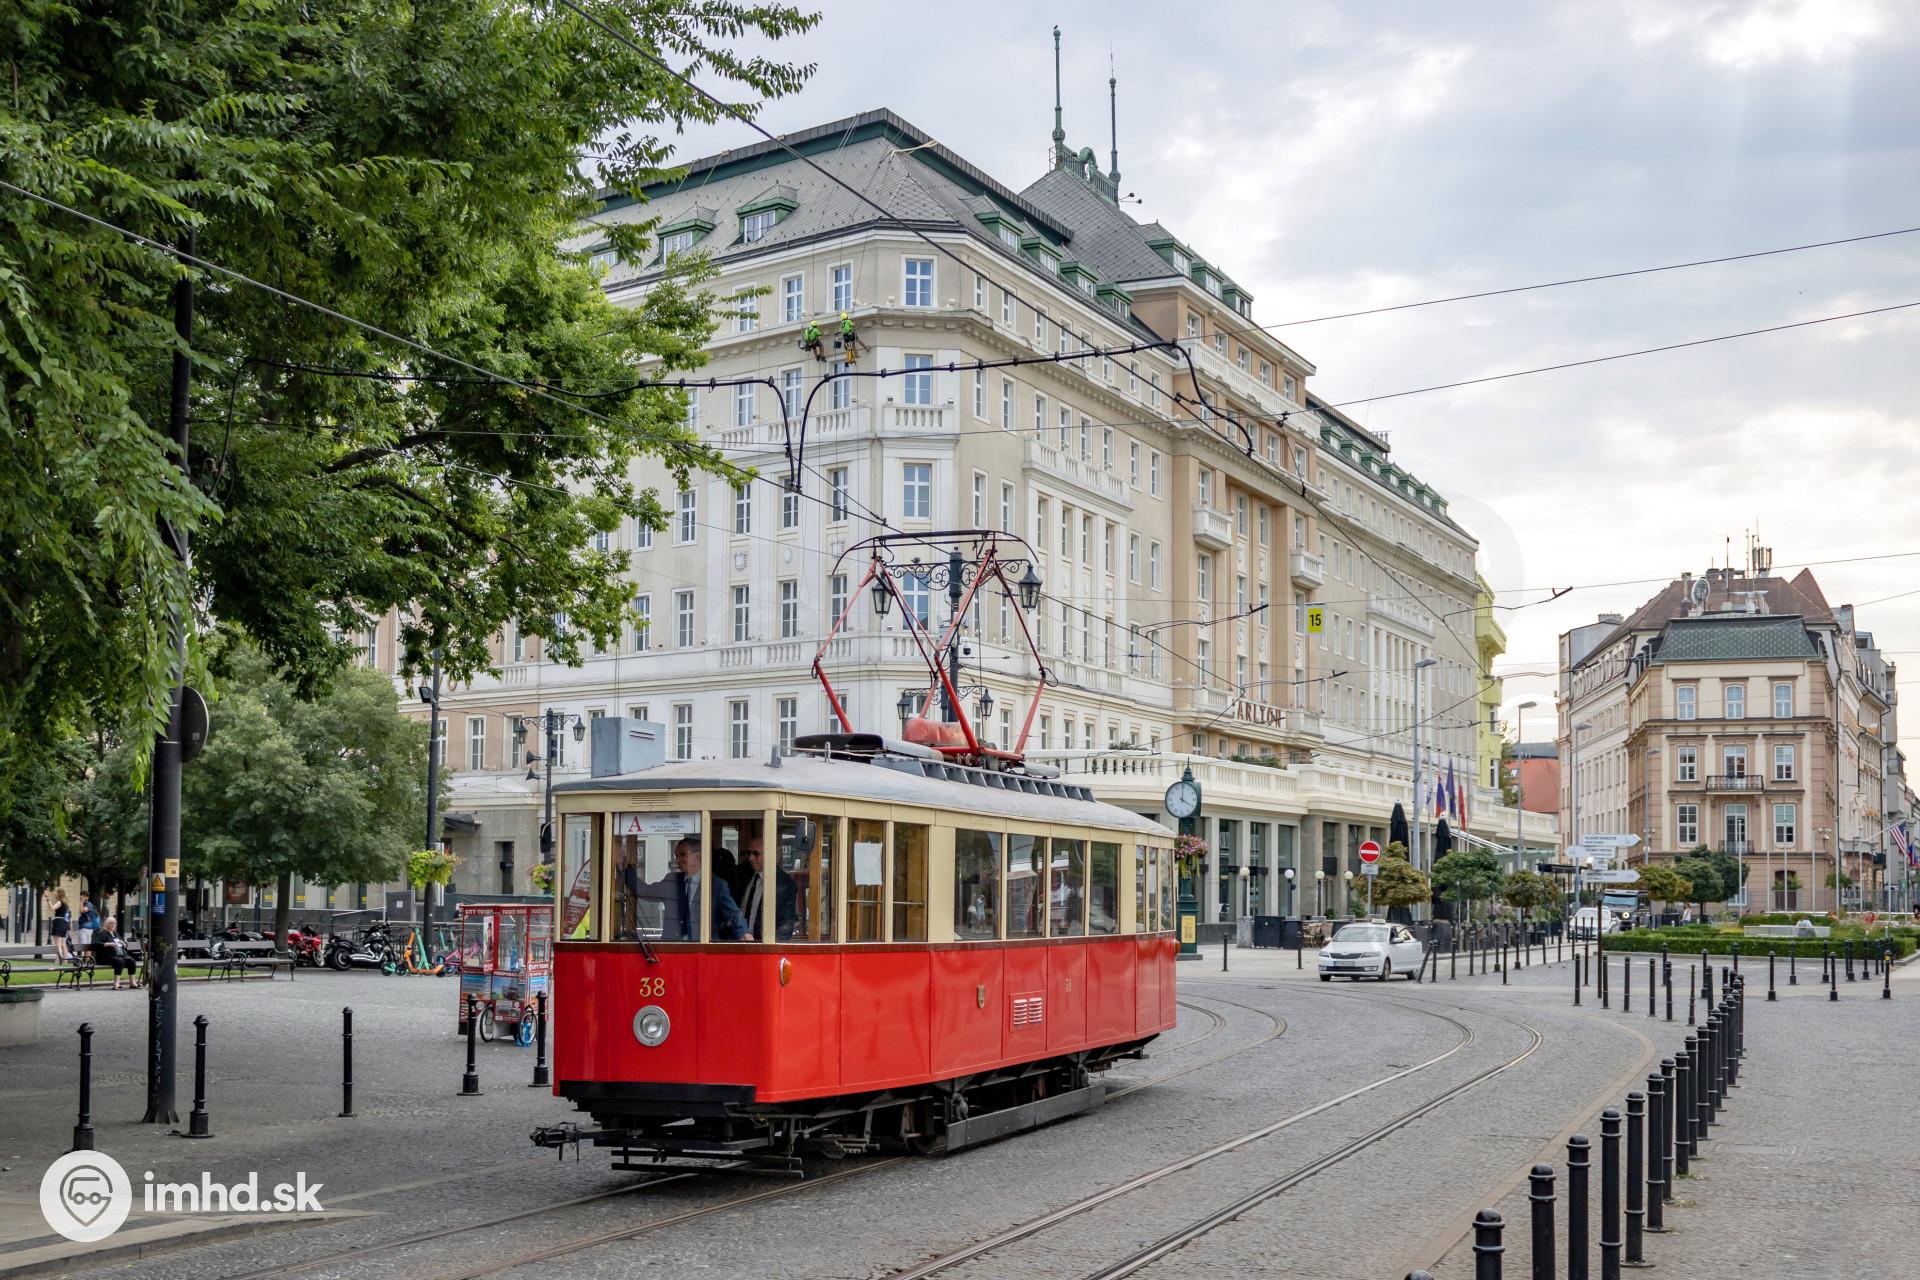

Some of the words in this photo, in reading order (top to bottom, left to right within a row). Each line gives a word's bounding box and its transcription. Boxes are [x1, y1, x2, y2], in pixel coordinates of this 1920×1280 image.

[1309, 613, 1322, 627] 15
[628, 815, 643, 833] A
[640, 977, 665, 997] 38
